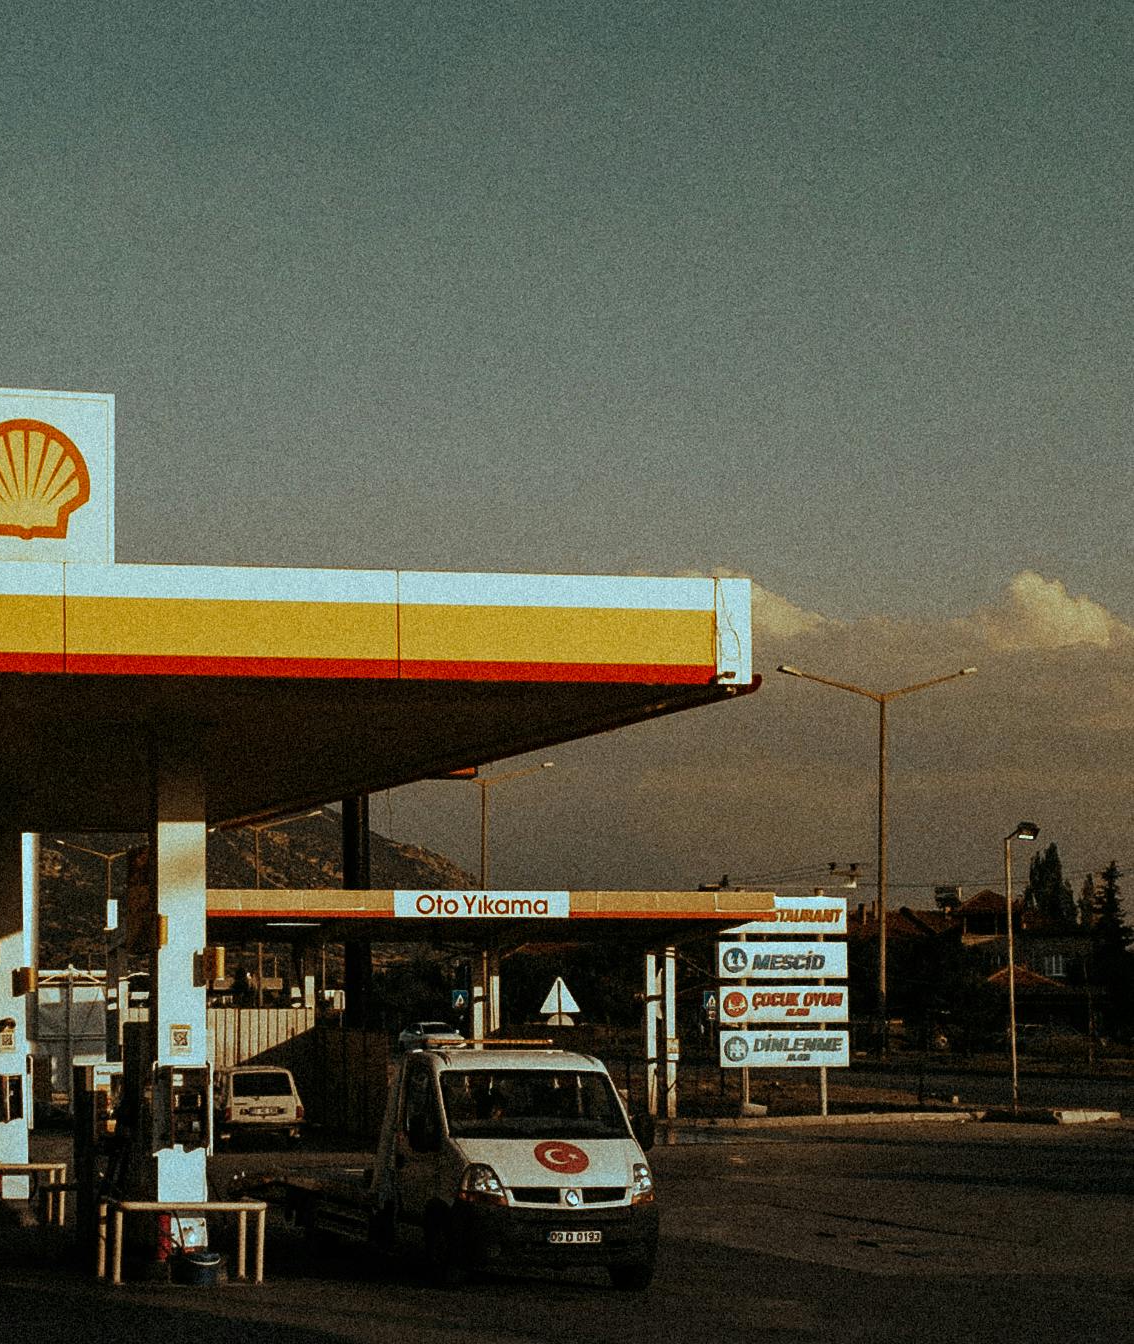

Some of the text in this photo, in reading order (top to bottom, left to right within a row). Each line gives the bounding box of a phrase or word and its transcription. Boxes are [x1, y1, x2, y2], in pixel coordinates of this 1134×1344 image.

[415, 894, 549, 915] Oto Yıkama
[752, 950, 826, 971] MESCİD
[751, 992, 844, 1010] ÇOCUK OYUN
[753, 1034, 844, 1052] DİNLENME
